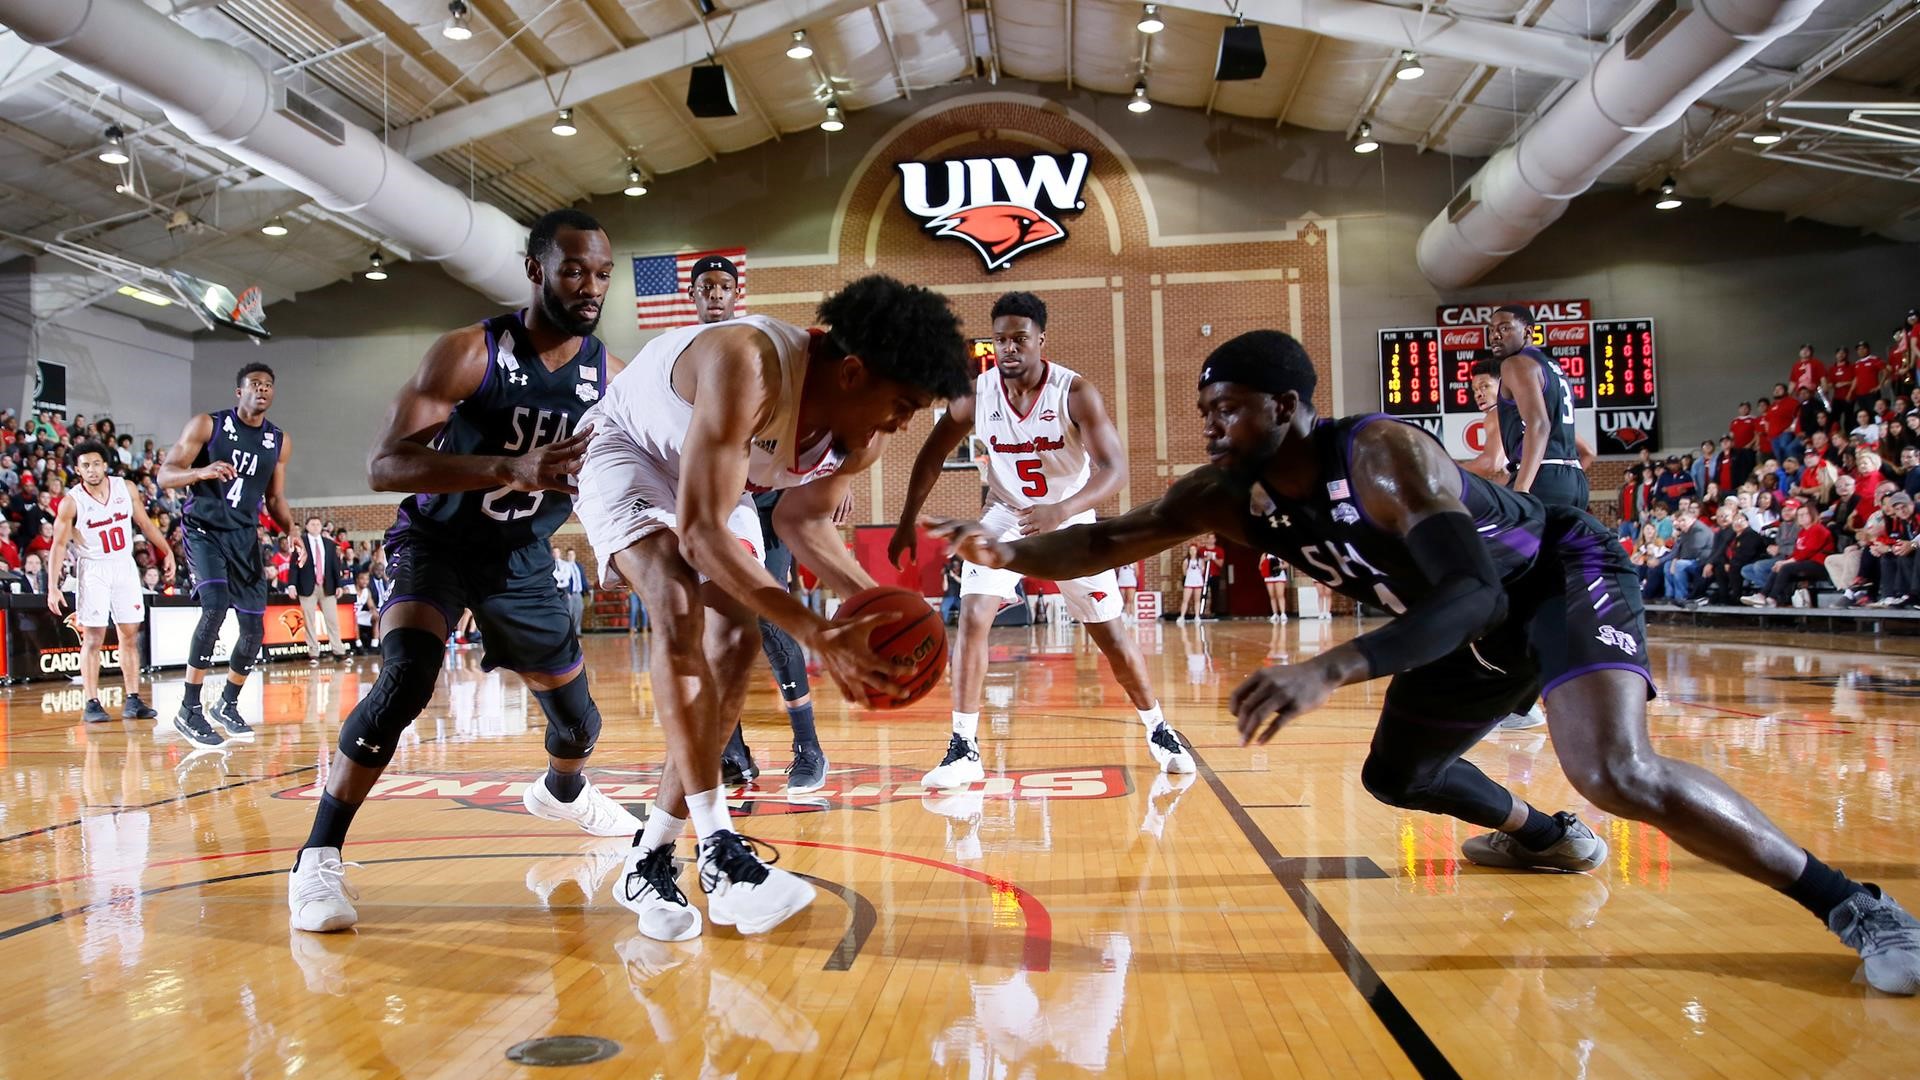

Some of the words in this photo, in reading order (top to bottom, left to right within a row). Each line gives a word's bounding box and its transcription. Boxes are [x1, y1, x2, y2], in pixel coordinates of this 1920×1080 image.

[898, 152, 1088, 217] UIW
[1442, 302, 1583, 325] CARALS
[1642, 332, 1650, 344] 5
[1410, 342, 1418, 353] 0
[1428, 341, 1437, 353] 0
[1552, 346, 1580, 356] GUEST
[1605, 345, 1613, 358] 3
[1623, 345, 1632, 356] 0
[1642, 344, 1651, 356] 0
[1410, 354, 1418, 365] 0
[1429, 353, 1437, 365] 5
[1456, 351, 1474, 360] UIW
[1559, 357, 1584, 377] 20
[1605, 359, 1614, 369] 4
[1643, 358, 1652, 368] 4
[1392, 366, 1400, 379] 5
[1429, 365, 1438, 377] 0
[1605, 370, 1614, 382] 5
[1624, 369, 1633, 380] 0
[1643, 369, 1652, 380] 6
[1411, 378, 1419, 389] 0
[1430, 377, 1438, 389] 0
[1598, 383, 1615, 396] 23
[1625, 382, 1634, 394] 0
[1644, 381, 1653, 394] 0
[1412, 390, 1420, 402] 0
[1430, 390, 1438, 402] 8
[1457, 389, 1468, 404] 6
[1573, 385, 1584, 399] 4
[1599, 411, 1655, 432] UIW
[232, 449, 258, 476] SFA
[1016, 459, 1048, 497] 5
[226, 477, 244, 508] 4
[99, 527, 125, 554] 10
[1137, 593, 1155, 619] RED
[40, 649, 120, 673] CARDALS
